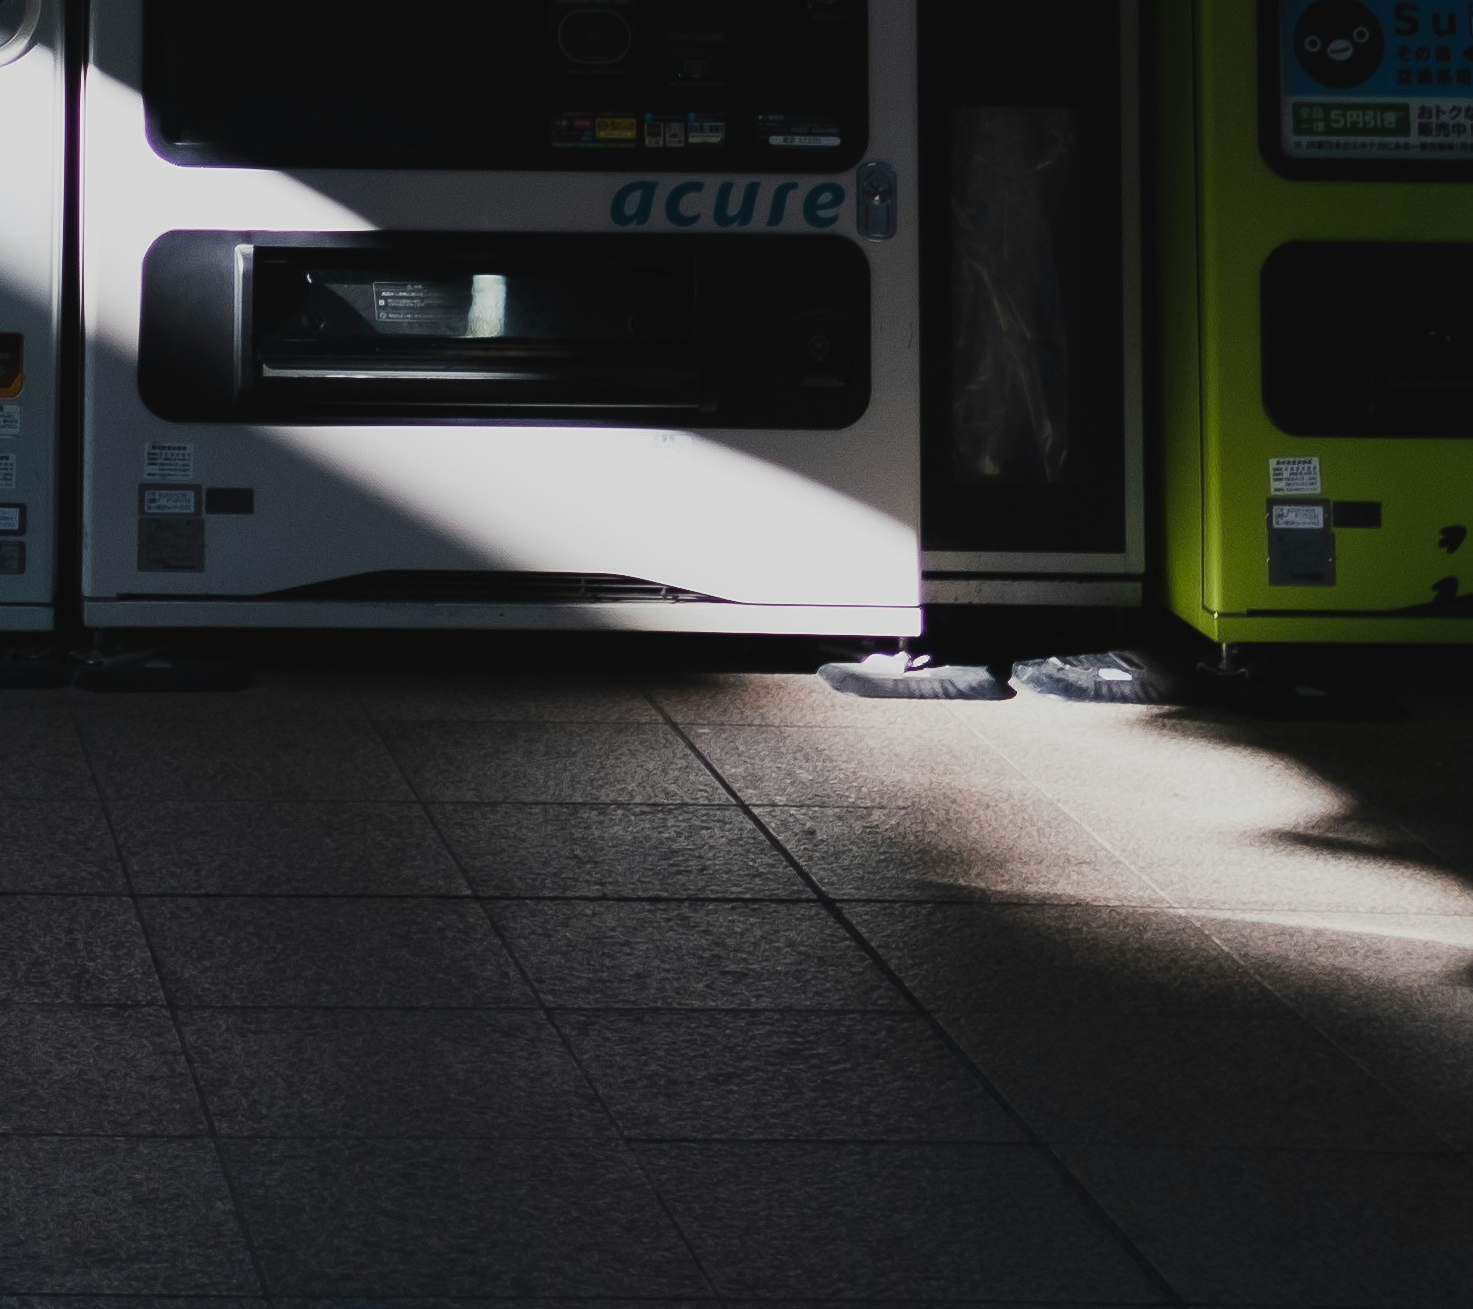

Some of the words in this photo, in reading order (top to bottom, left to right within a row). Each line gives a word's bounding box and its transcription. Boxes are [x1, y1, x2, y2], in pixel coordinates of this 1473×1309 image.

[1395, 46, 1452, 63] その他
[609, 180, 847, 228] acure
